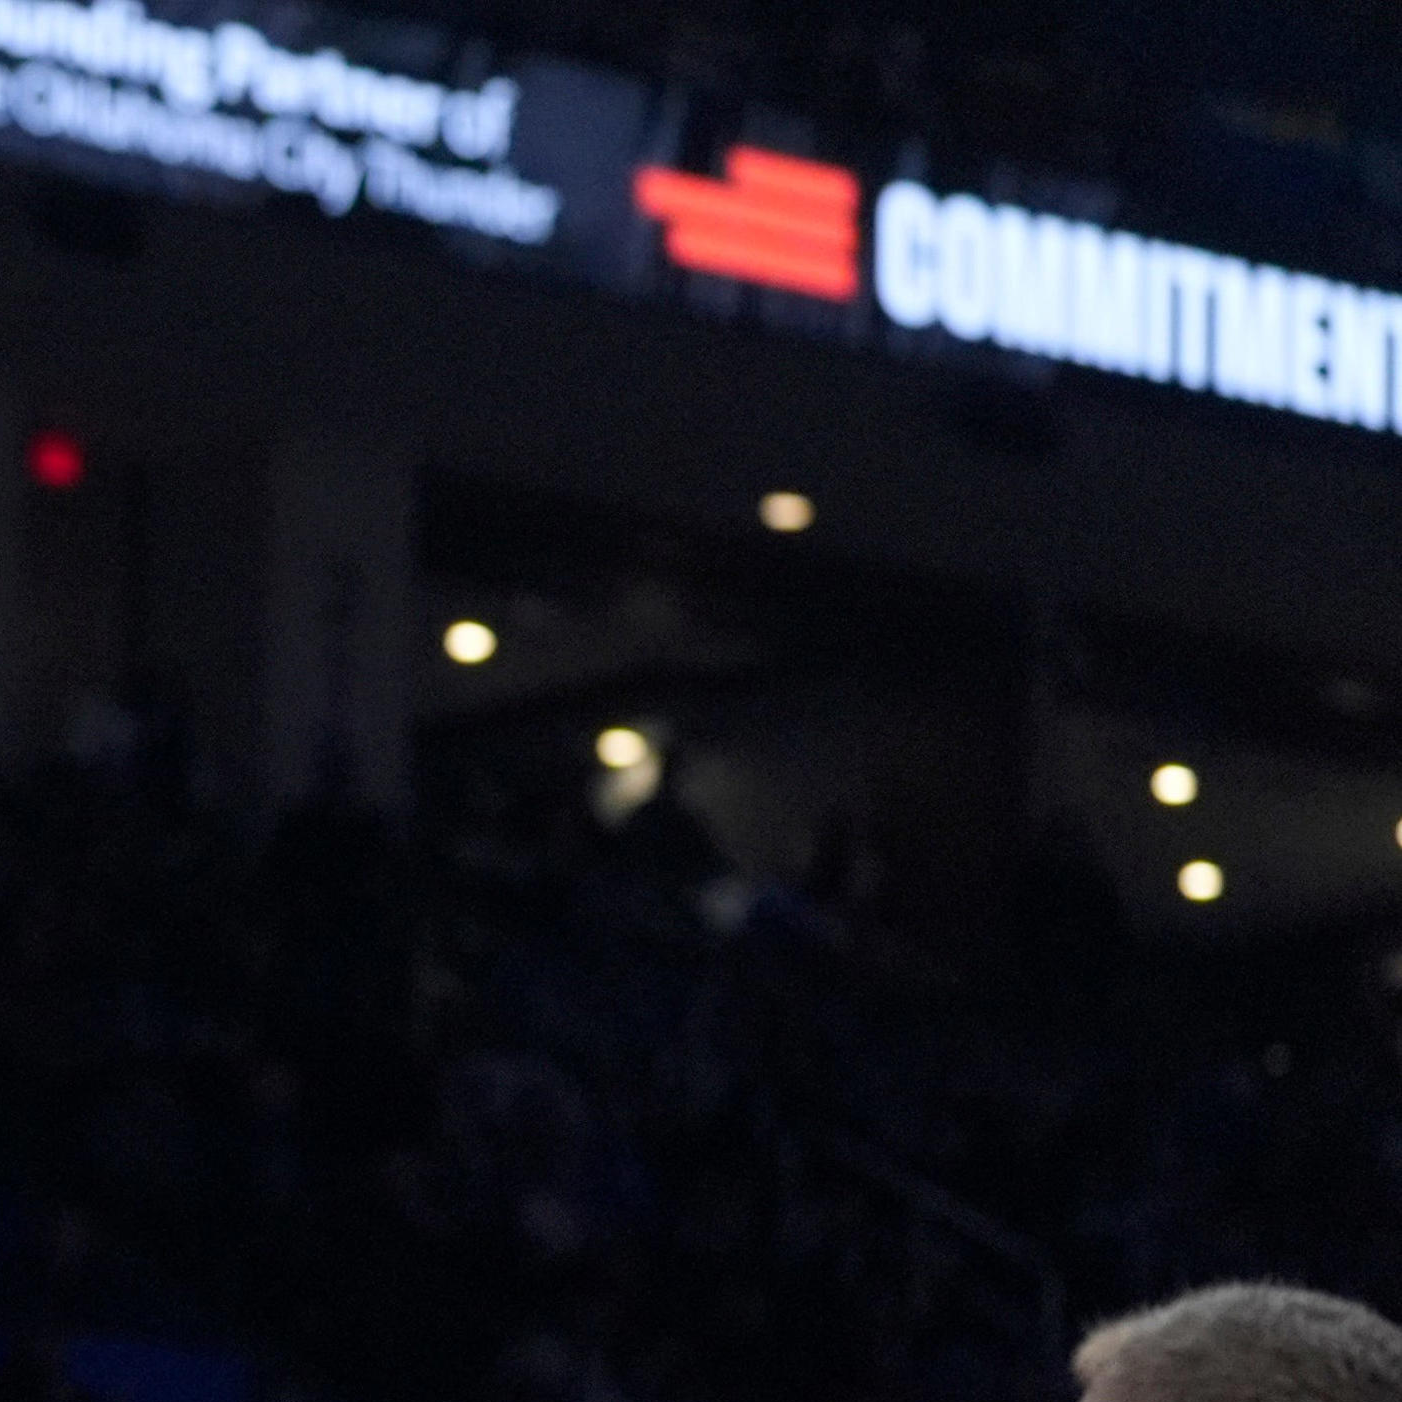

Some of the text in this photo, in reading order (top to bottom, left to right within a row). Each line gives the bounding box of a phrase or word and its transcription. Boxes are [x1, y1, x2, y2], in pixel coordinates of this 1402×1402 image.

[214, 22, 443, 147] Partner
[443, 77, 518, 159] of
[261, 115, 362, 216] City
[364, 137, 559, 245] Thunder
